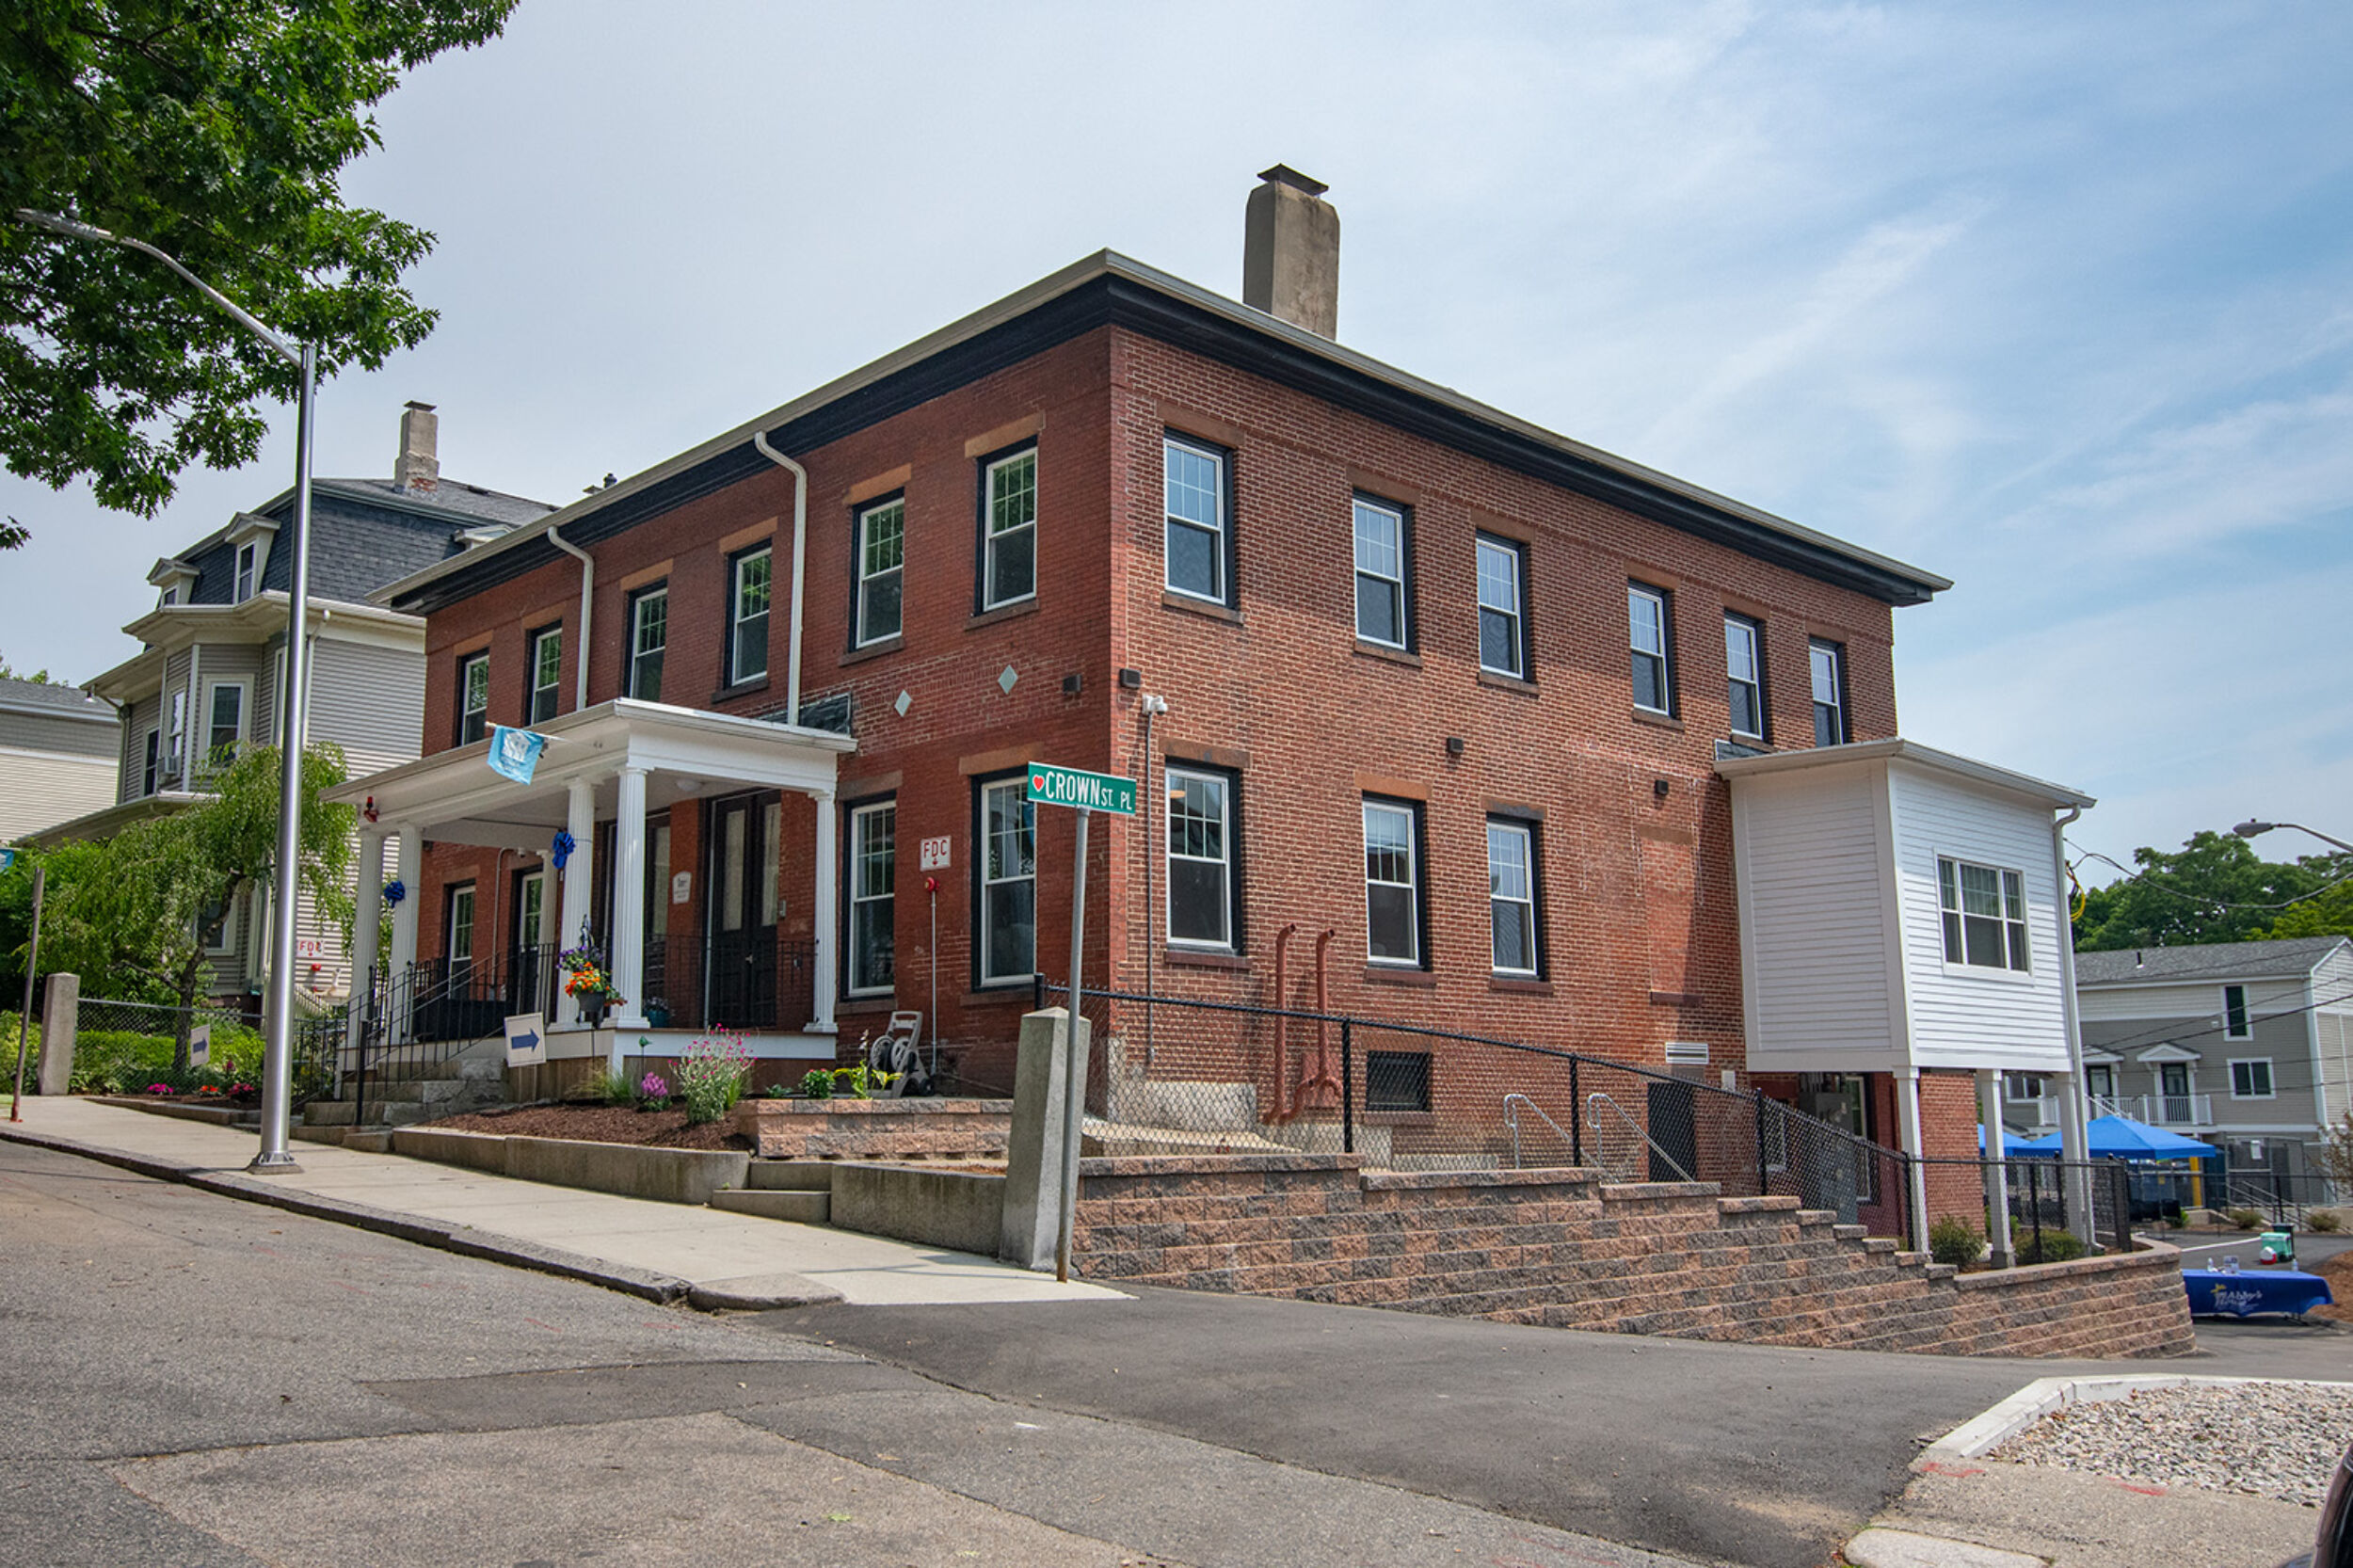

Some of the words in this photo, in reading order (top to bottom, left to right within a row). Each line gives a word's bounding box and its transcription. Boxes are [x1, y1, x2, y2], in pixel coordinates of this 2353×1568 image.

[1045, 771, 1100, 805] CROWN
[1120, 792, 1132, 810] PL
[924, 840, 947, 858] FDC
